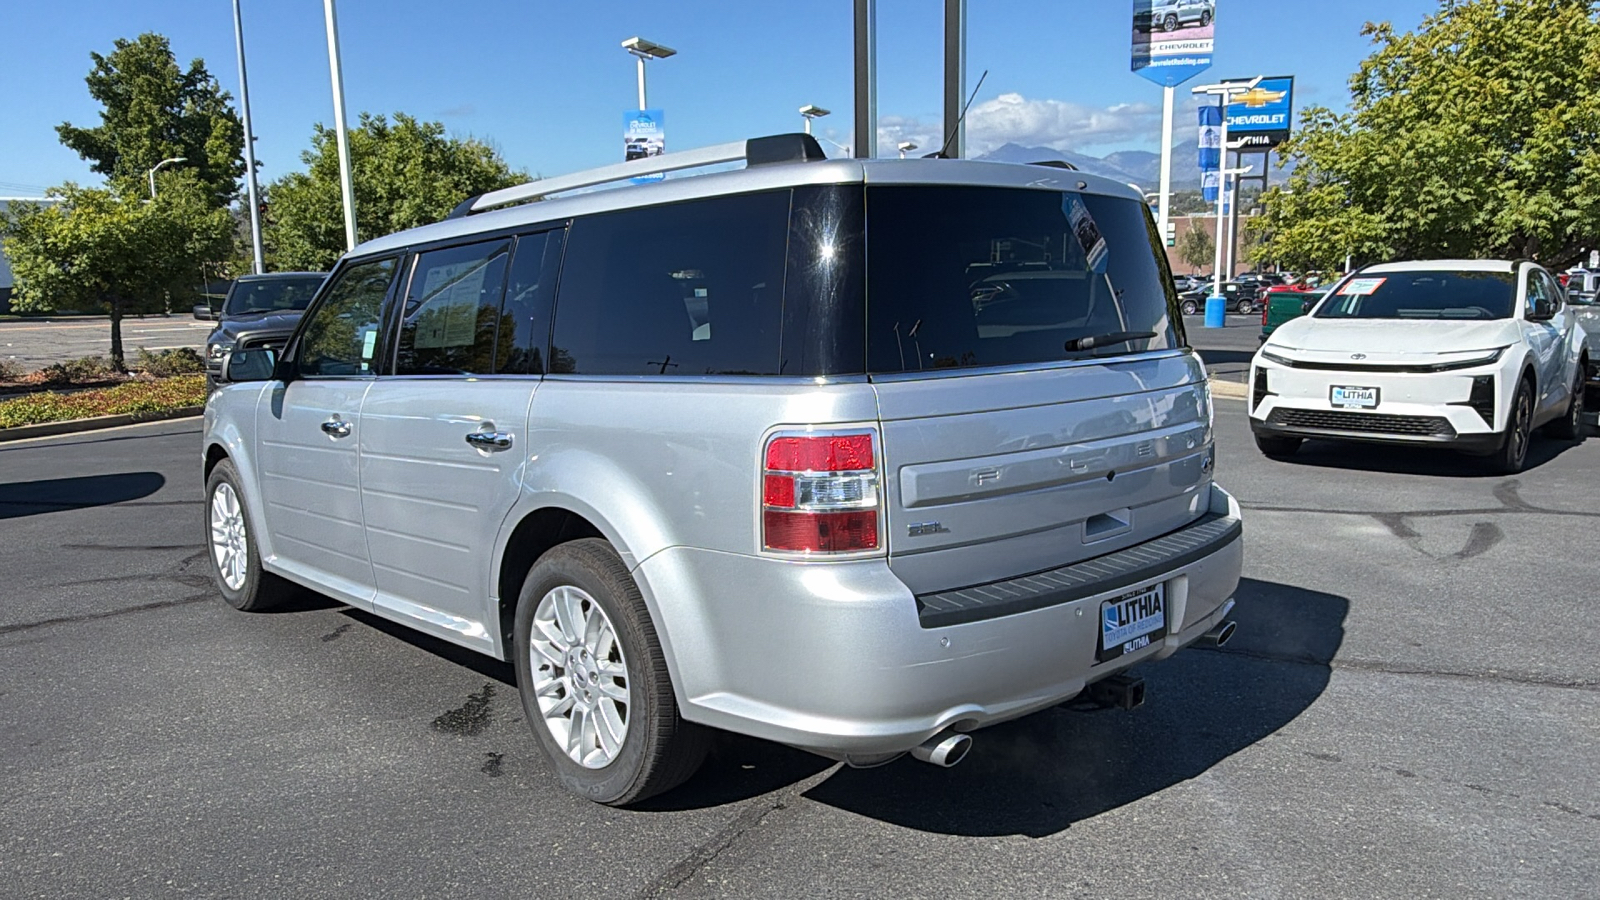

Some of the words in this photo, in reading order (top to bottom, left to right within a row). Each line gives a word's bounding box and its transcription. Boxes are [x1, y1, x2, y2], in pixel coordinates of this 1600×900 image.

[1160, 42, 1209, 50] CHEVROLET
[1226, 113, 1285, 126] CHEVROLET
[1238, 135, 1270, 145] LTHIA
[1343, 391, 1373, 399] LITHIA
[1117, 591, 1162, 627] LITHIA
